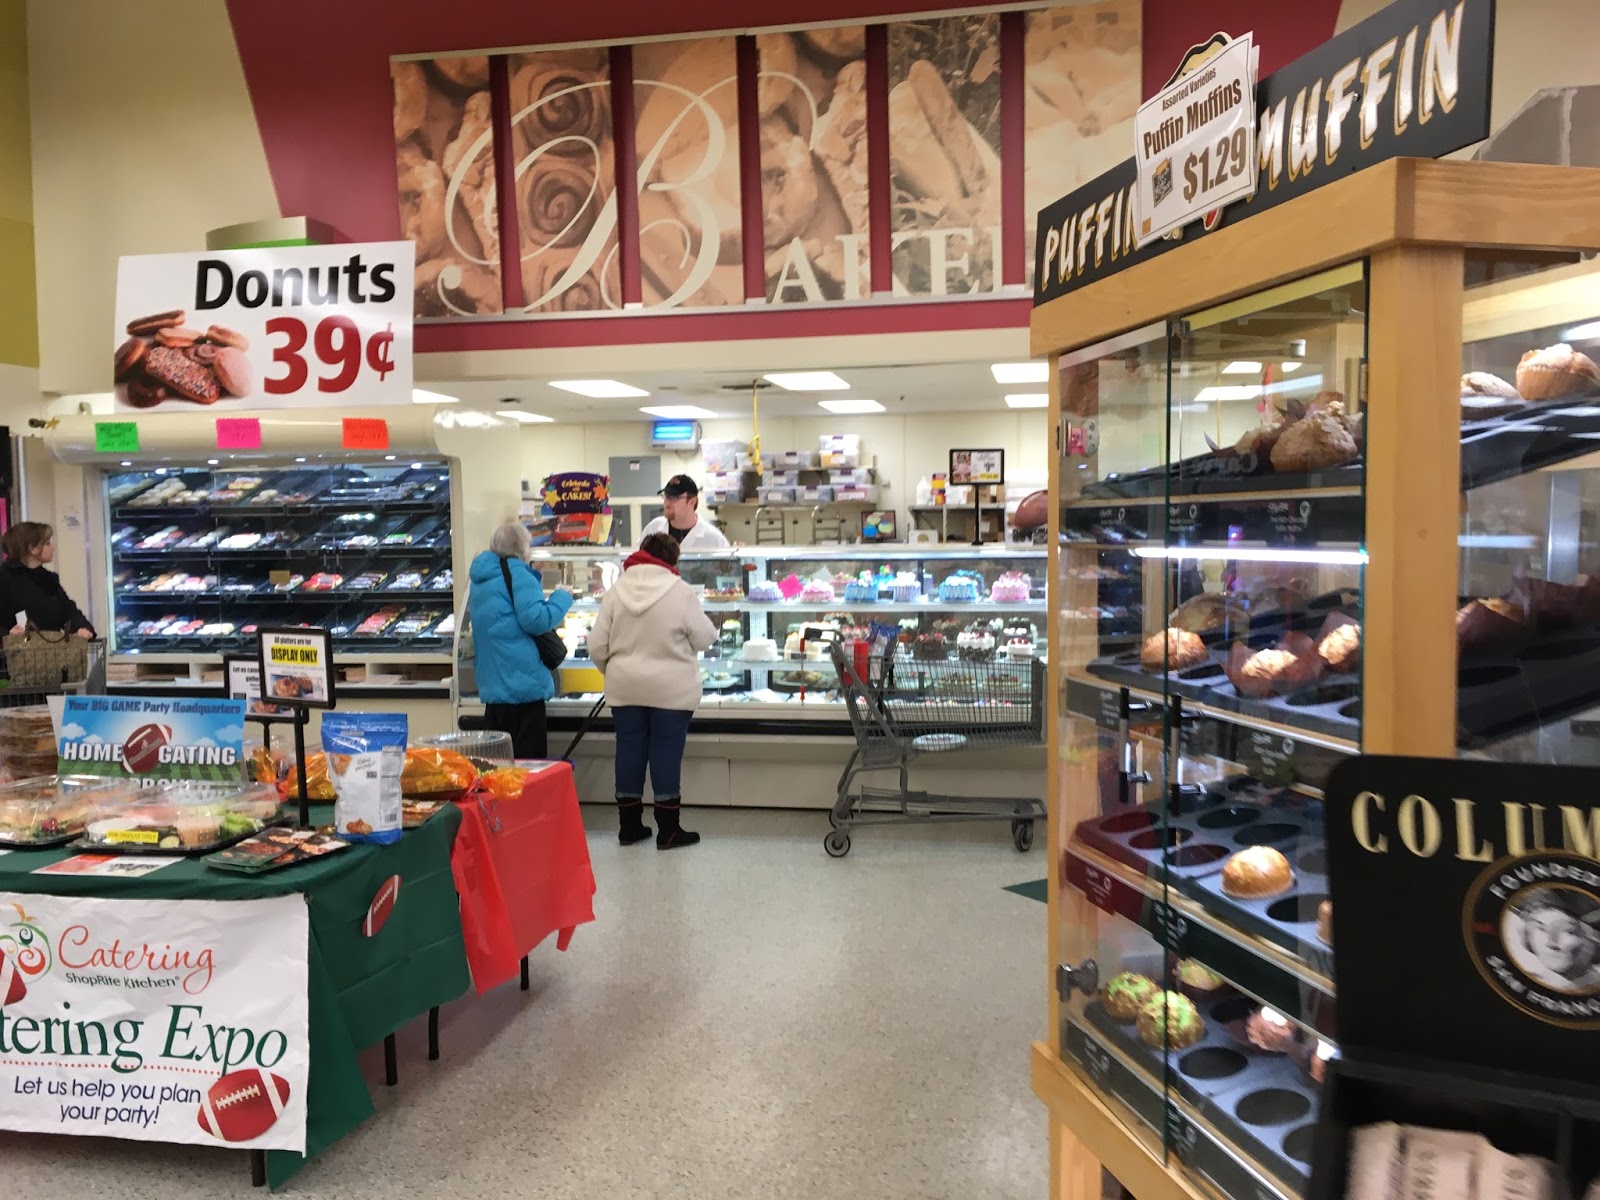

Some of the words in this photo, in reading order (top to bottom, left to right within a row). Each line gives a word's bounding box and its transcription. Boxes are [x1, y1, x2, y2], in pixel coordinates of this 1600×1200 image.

[1162, 85, 1189, 112] Assorted
[1189, 67, 1217, 95] Varieties
[1255, 0, 1464, 192] MUFFIN
[1143, 114, 1184, 160] Puffin
[1186, 78, 1242, 135] Muffins
[1183, 126, 1247, 204] $1.29
[194, 254, 396, 310] Donuts
[263, 314, 395, 394] 39¢
[271, 648, 298, 661] DISPLAY
[300, 649, 318, 663] ONLY
[68, 700, 89, 712] Your
[91, 700, 109, 712] BIG
[111, 701, 141, 712] GAME
[143, 701, 170, 715] Party
[172, 702, 241, 715] Headquarters
[63, 742, 124, 762] HOME
[158, 745, 236, 765] GATING
[58, 925, 216, 994] Catering
[65, 972, 121, 987] ShopRite
[159, 1004, 288, 1077] Expo
[14, 1076, 42, 1095] Let
[48, 1081, 67, 1096] us
[72, 1079, 115, 1102] help
[121, 1083, 154, 1103] you
[160, 1083, 201, 1105] plan
[60, 1104, 101, 1122] your
[104, 1106, 160, 1128] party!
